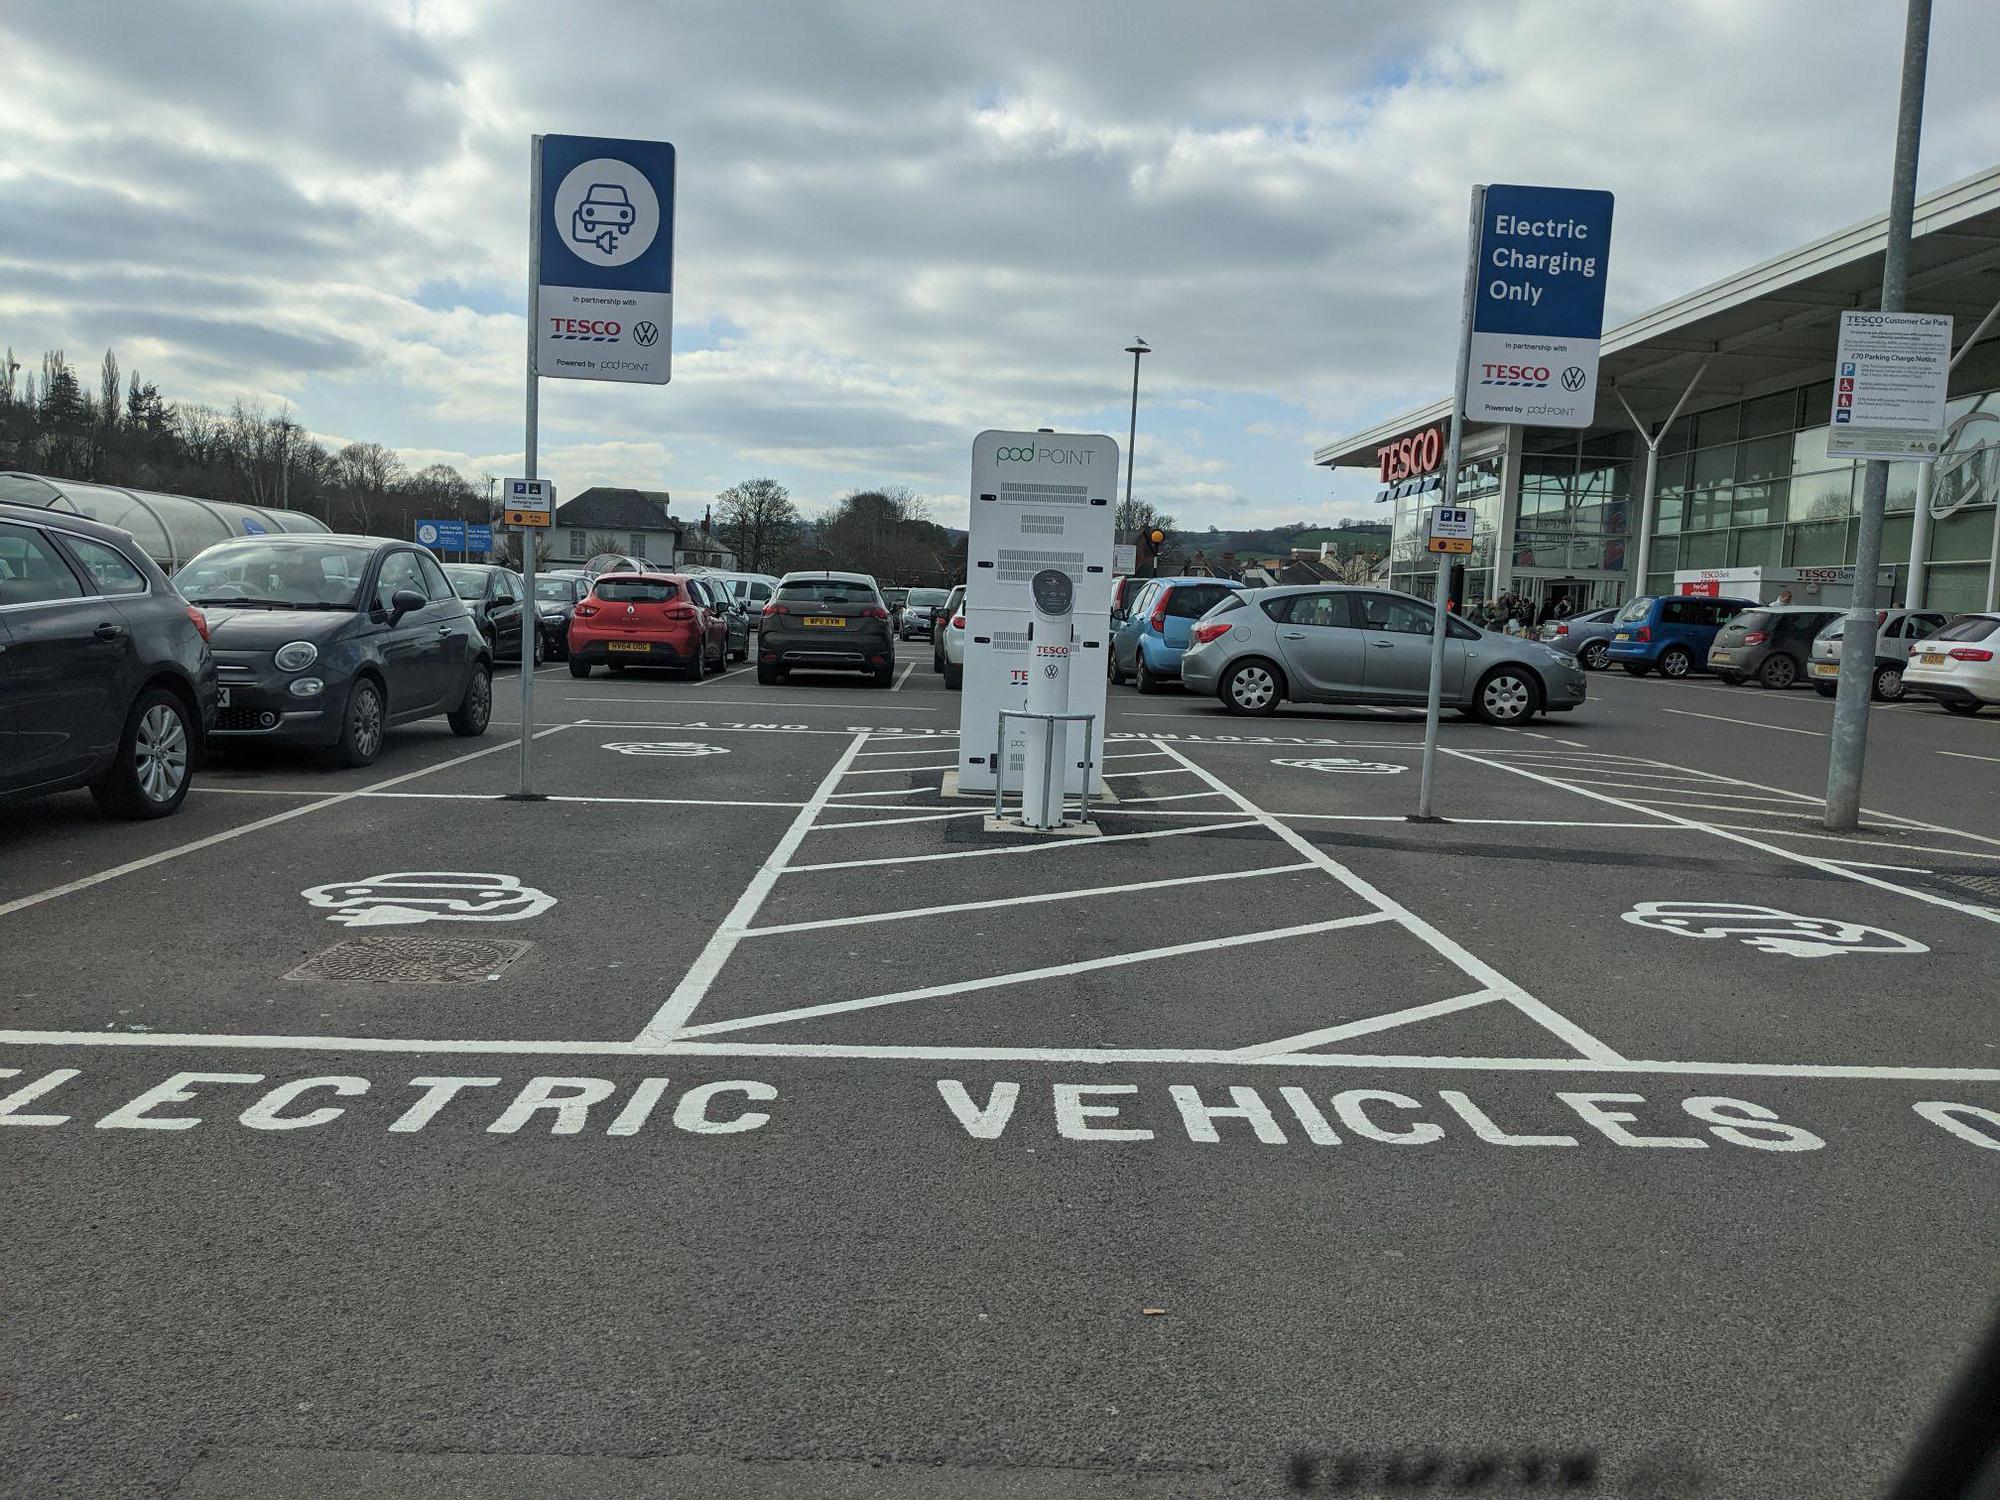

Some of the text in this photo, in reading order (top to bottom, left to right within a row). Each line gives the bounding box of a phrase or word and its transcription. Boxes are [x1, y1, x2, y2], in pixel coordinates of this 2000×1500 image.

[1496, 215, 1588, 239] Electric
[1492, 248, 1596, 277] Charging
[1490, 280, 1543, 306] Only
[580, 296, 621, 306] partnership
[622, 298, 637, 306] with
[550, 318, 621, 336] TESCO
[1846, 315, 1884, 324] TESCO
[1884, 317, 1919, 325] Customer
[1513, 342, 1552, 353] partnership
[1553, 344, 1568, 352] with
[556, 358, 650, 372] Powered by pod POINT
[1864, 353, 1890, 362] Parking
[1891, 354, 1915, 362] Charge
[1915, 355, 1937, 363] Notice
[1482, 364, 1550, 381] TESCO
[1485, 404, 1575, 416] Powered by pod POINT
[996, 441, 1096, 467] pod POINT
[1377, 428, 1442, 483] TESCO
[1796, 569, 1855, 579] TESCO Ban
[1036, 646, 1069, 655] TESCO
[1108, 732, 1339, 744] ELECTRIC
[0, 1068, 1826, 1151] LECTRIC VEHICLES
